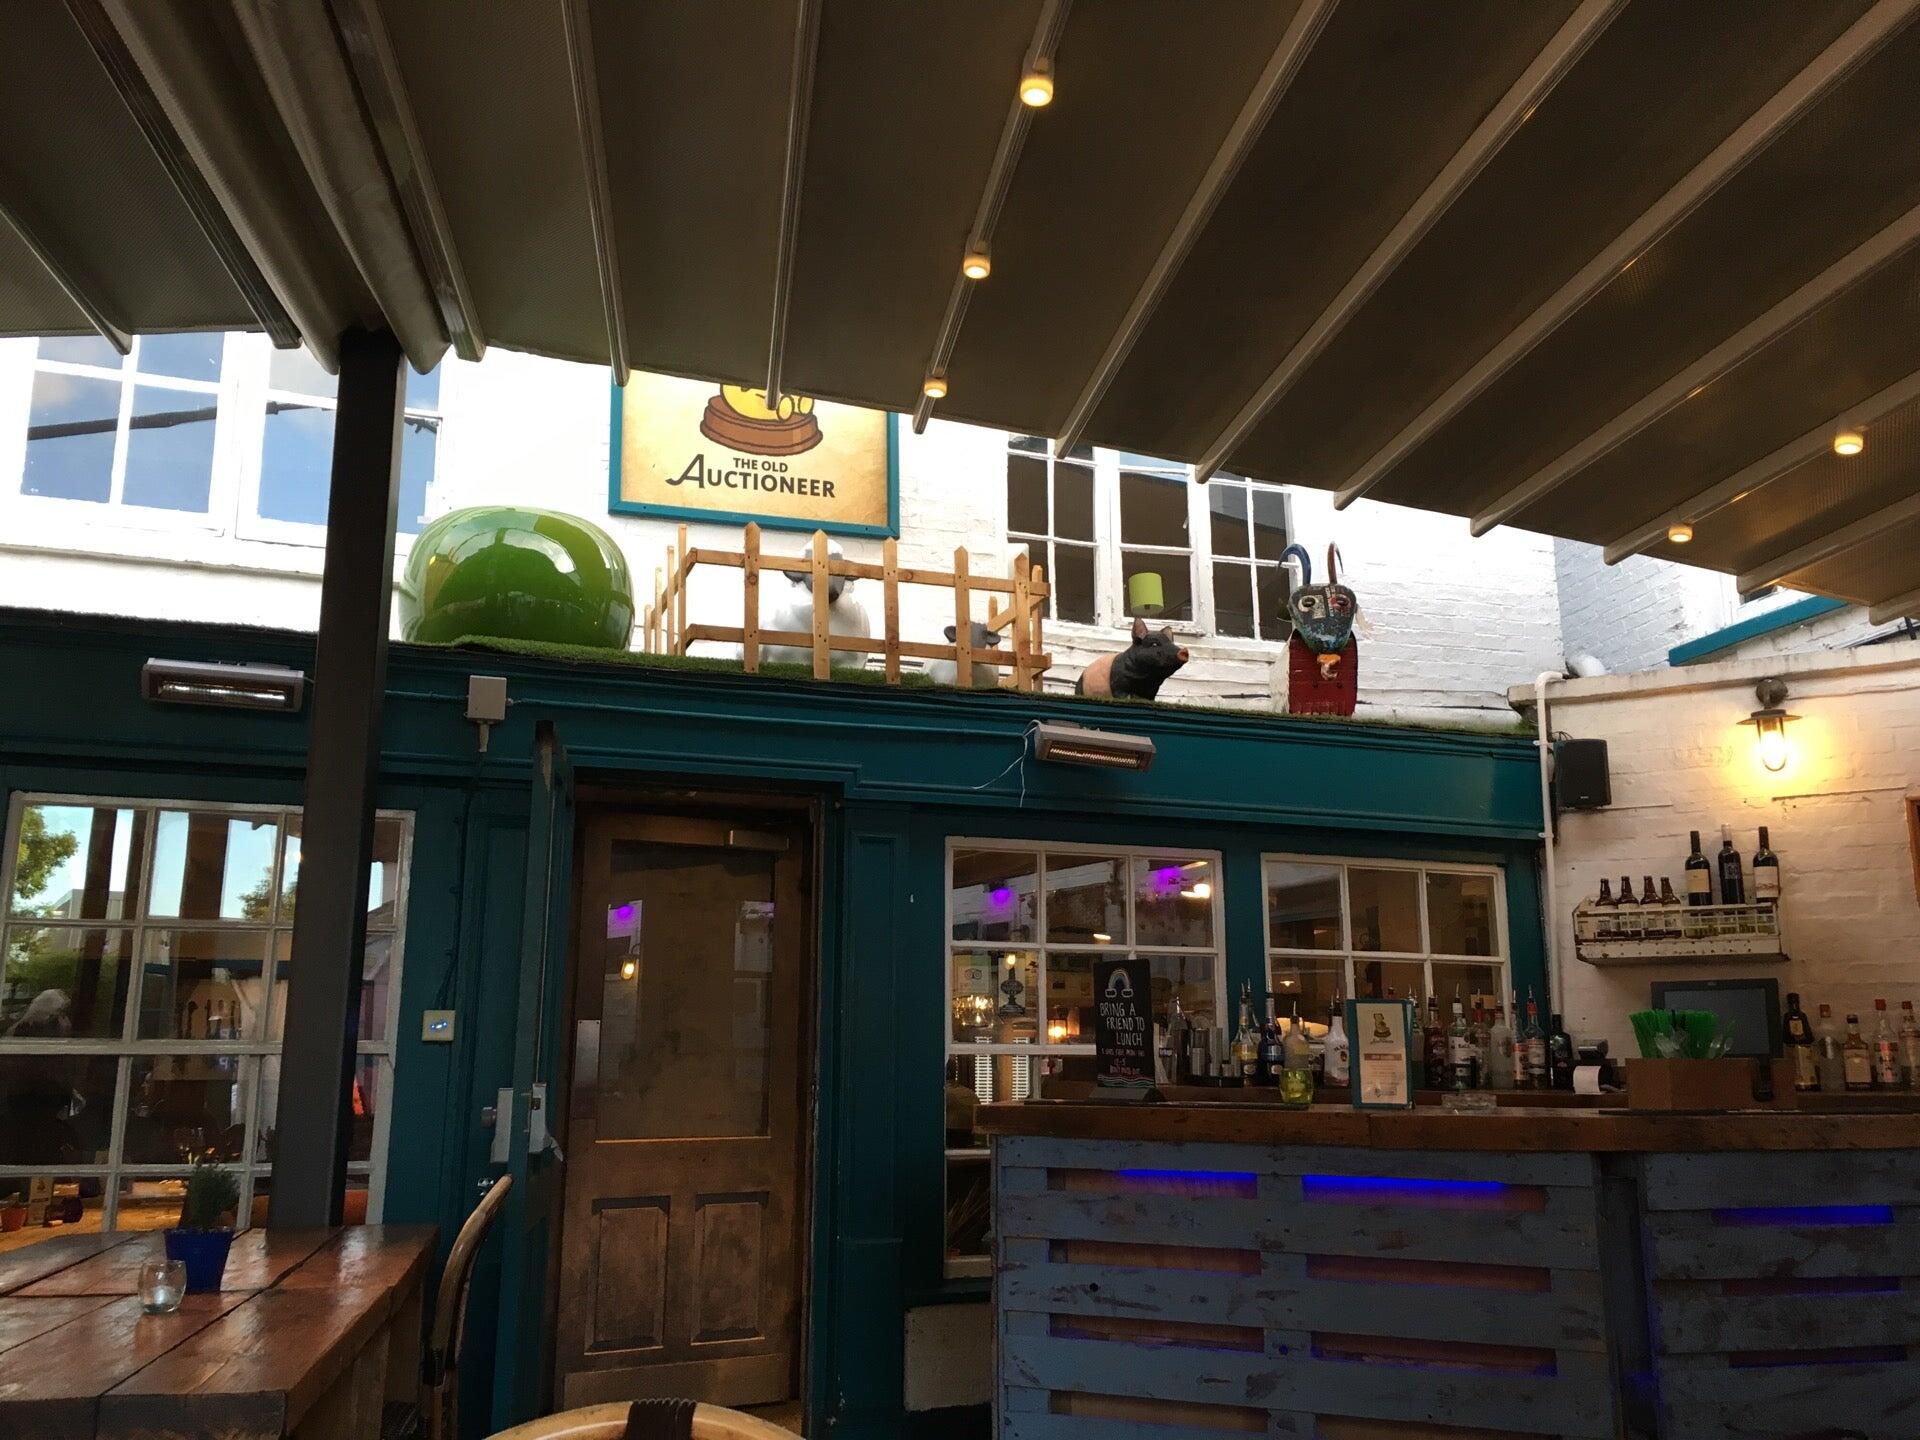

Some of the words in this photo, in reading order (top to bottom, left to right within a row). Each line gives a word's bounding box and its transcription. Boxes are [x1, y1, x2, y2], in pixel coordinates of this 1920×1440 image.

[733, 457, 758, 470] THE
[761, 460, 788, 473] OLD
[665, 454, 836, 498] AUCTIONEER
[1100, 1002, 1125, 1017] BRING
[1129, 1002, 1136, 1017] A
[1106, 1017, 1134, 1031] FRIEND
[1134, 1017, 1145, 1031] TO
[1116, 1032, 1142, 1046] LUNCH
